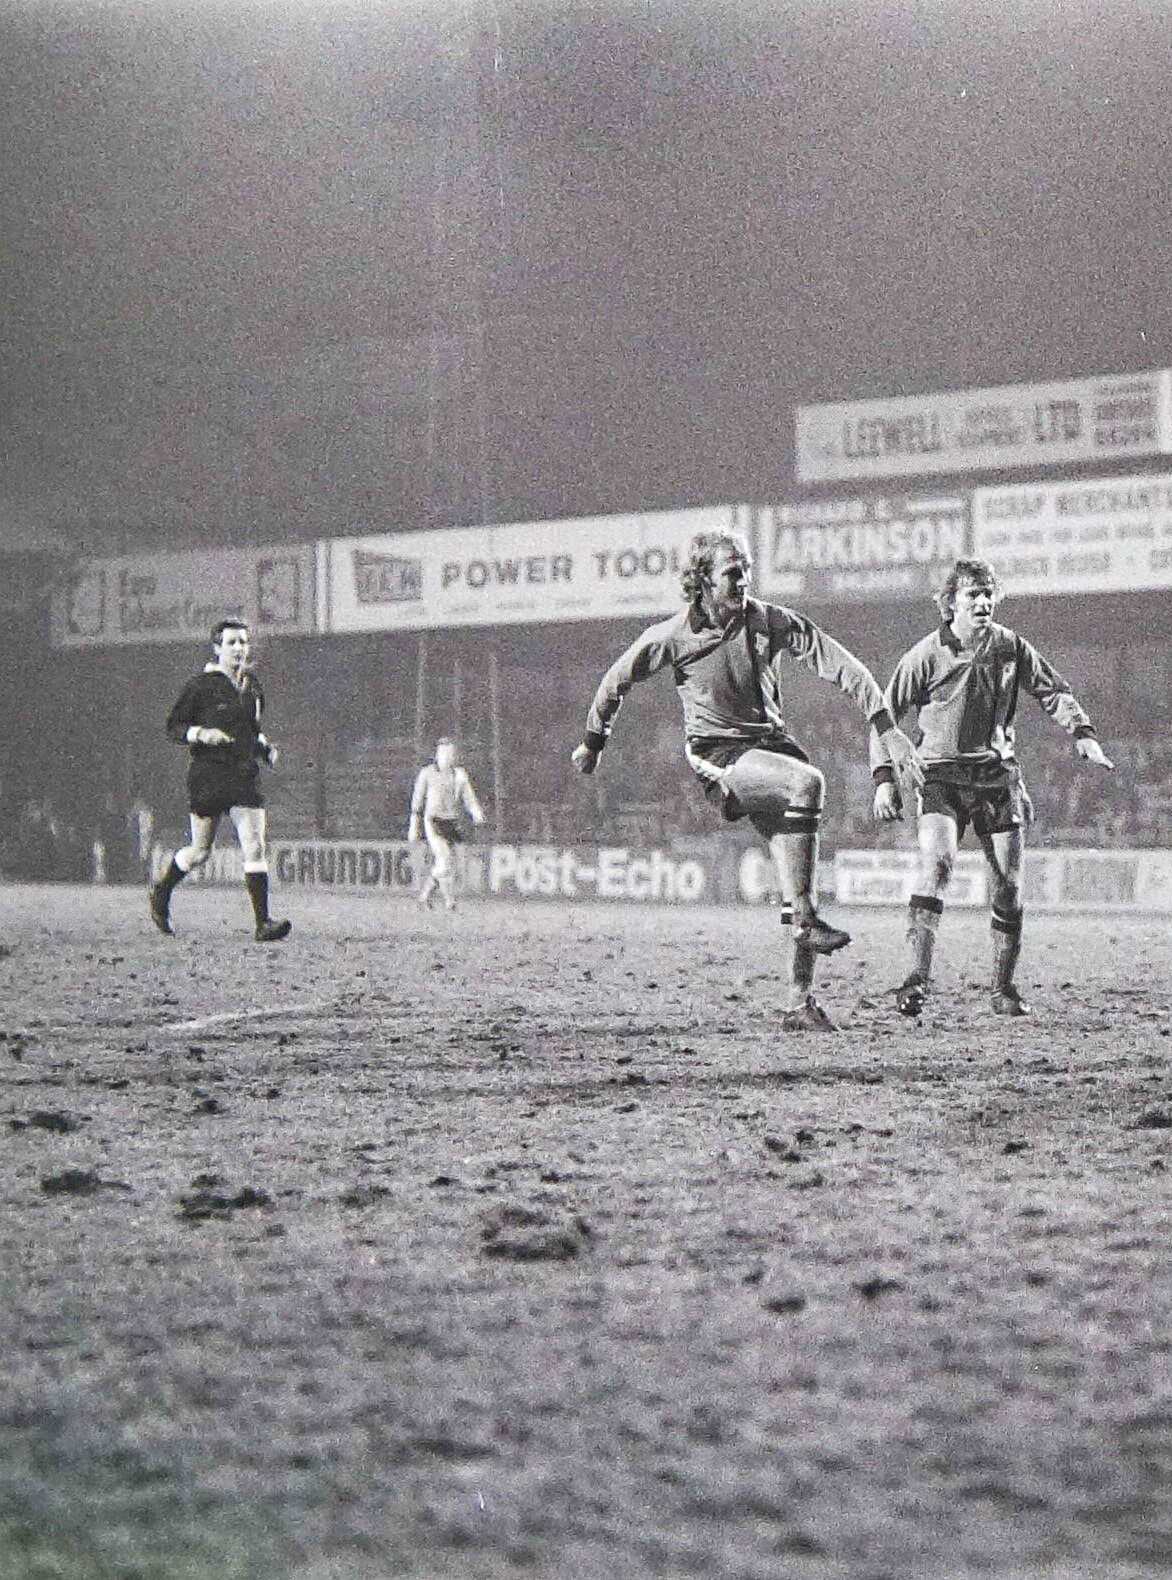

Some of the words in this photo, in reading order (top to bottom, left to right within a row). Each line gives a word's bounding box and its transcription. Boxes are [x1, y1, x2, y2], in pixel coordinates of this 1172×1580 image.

[441, 553, 573, 592] POWER
[277, 848, 412, 886] GRUNDIG
[490, 846, 705, 902] Post-Echo
